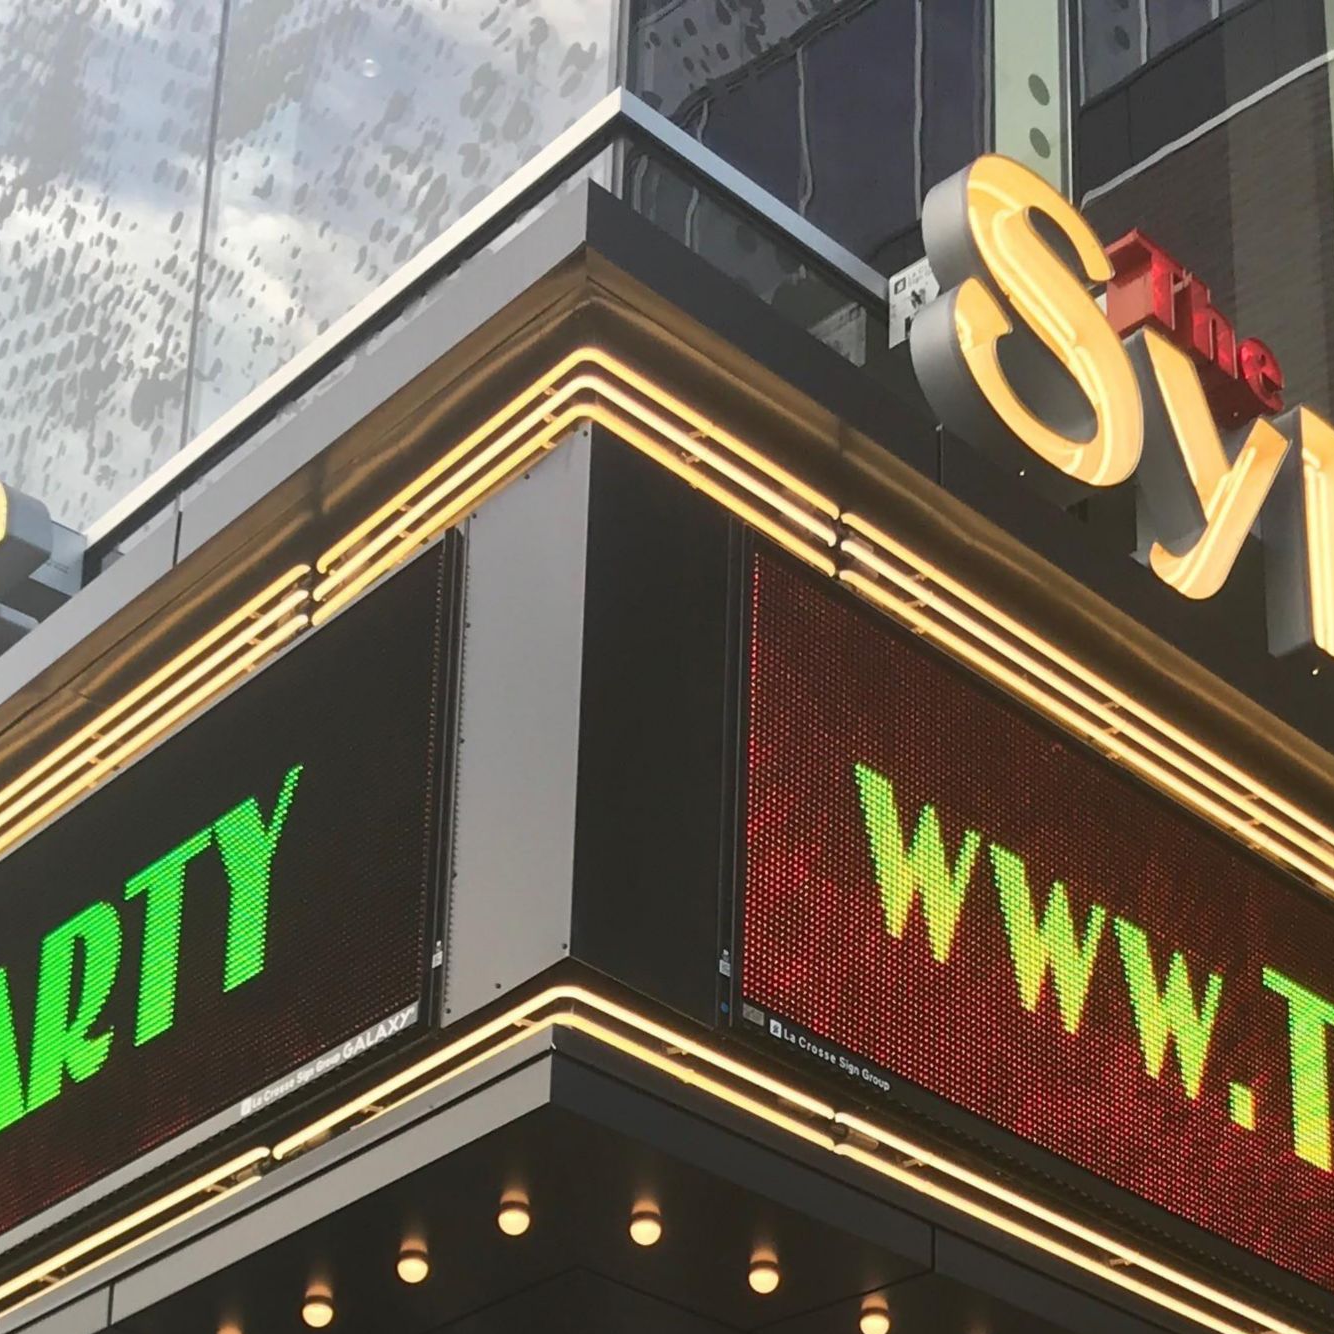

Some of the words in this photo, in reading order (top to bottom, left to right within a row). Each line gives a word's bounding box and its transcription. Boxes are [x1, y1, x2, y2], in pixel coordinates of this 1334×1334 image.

[783, 1028, 796, 1044] La
[798, 1036, 836, 1064] Crosse
[839, 1056, 860, 1076] Sign
[861, 1070, 890, 1091] Group
